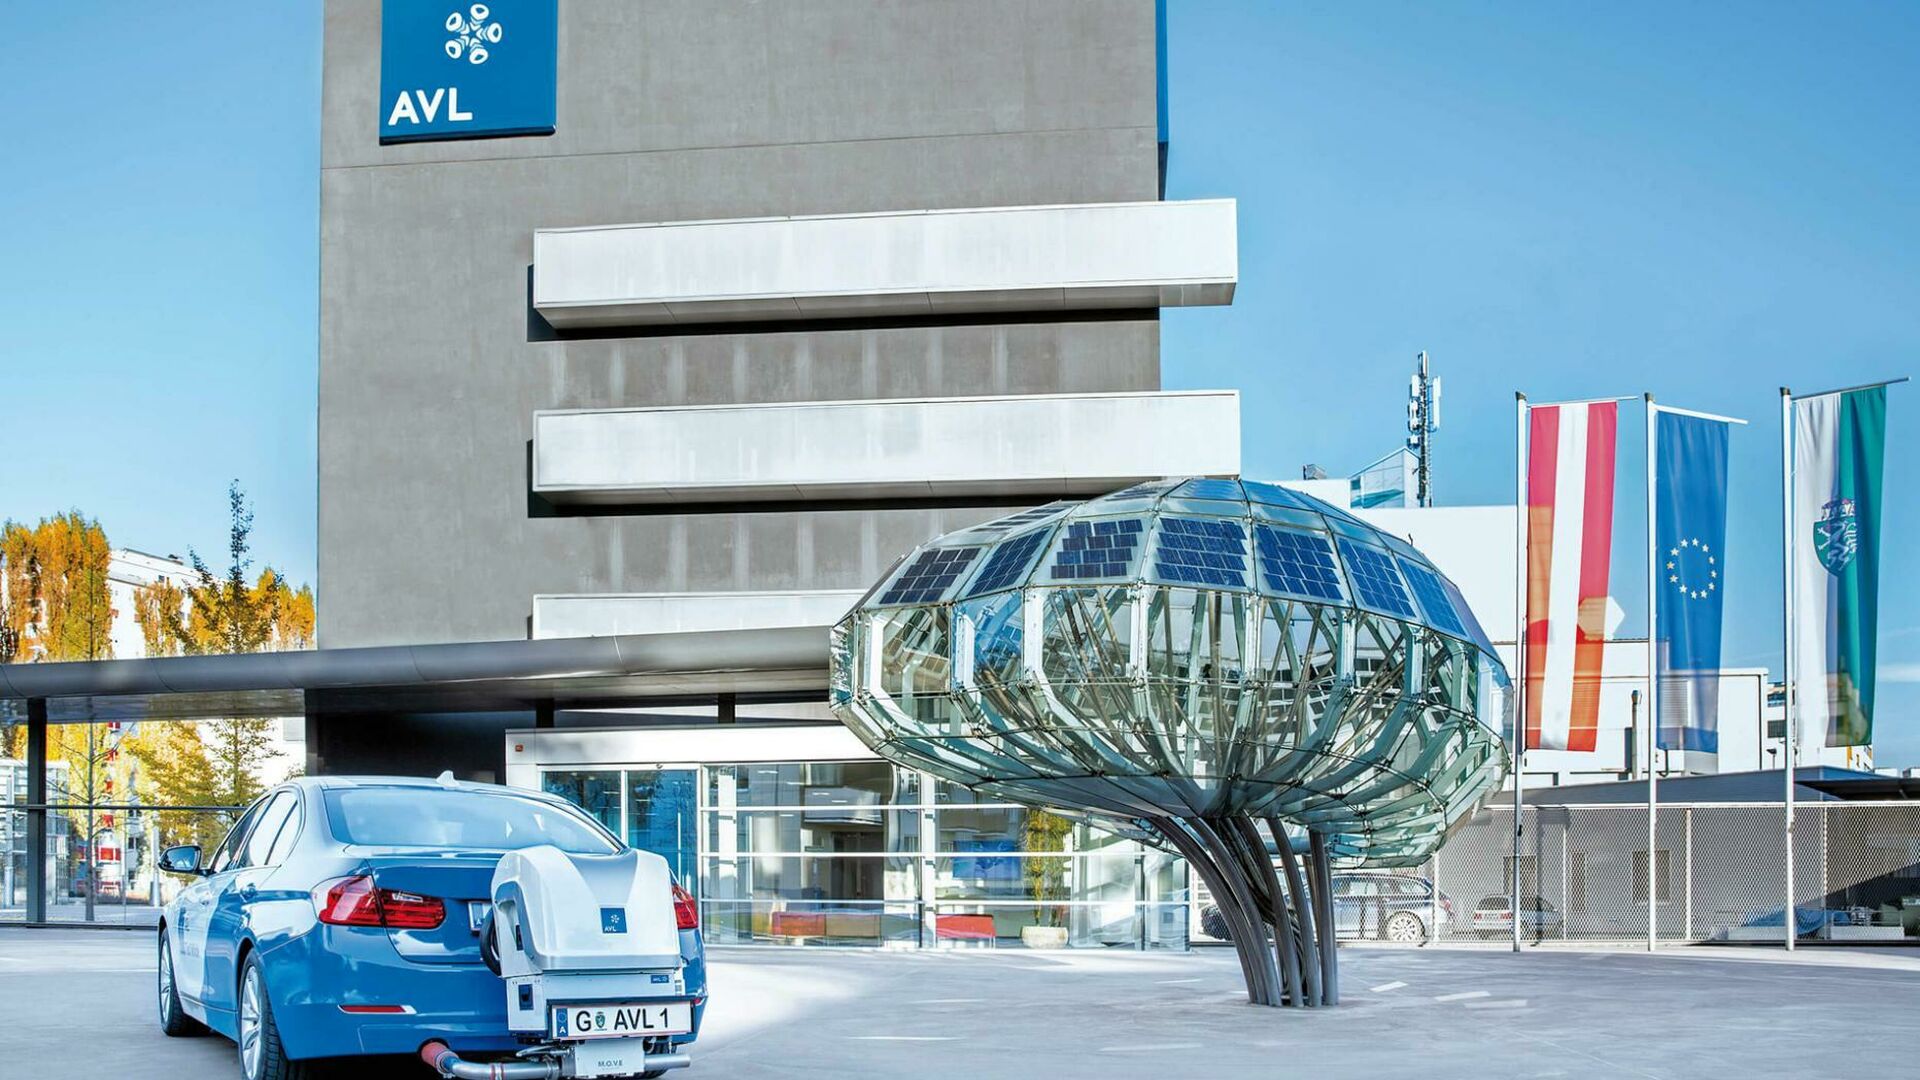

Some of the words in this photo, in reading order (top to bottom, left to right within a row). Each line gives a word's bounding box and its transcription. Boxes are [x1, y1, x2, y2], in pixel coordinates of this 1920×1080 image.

[388, 87, 473, 126] AVL
[576, 1010, 592, 1032] G
[614, 1007, 655, 1031] AVL
[659, 1007, 668, 1028] 1
